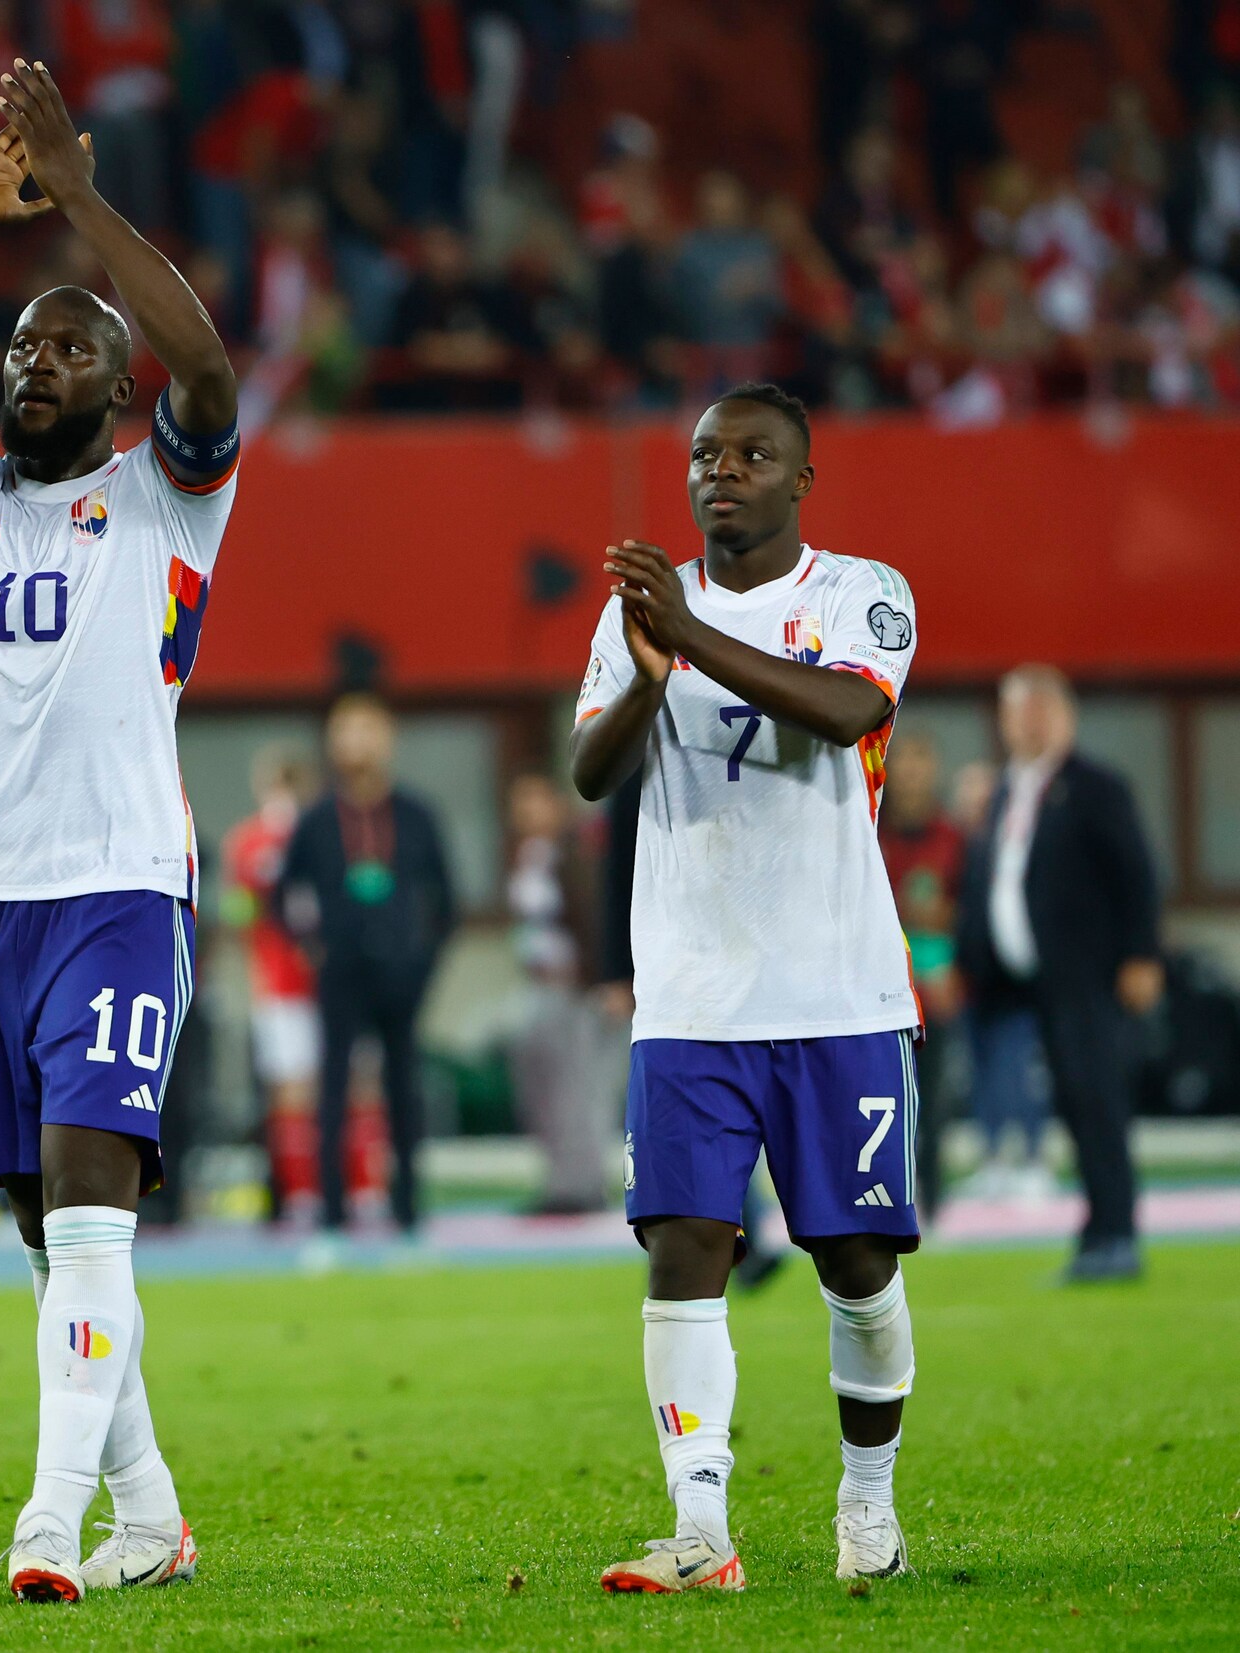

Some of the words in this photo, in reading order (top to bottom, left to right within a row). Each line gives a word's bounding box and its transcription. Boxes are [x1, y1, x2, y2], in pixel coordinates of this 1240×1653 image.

[719, 704, 762, 782] 7
[86, 987, 167, 1072] 10
[857, 1096, 896, 1173] 7
